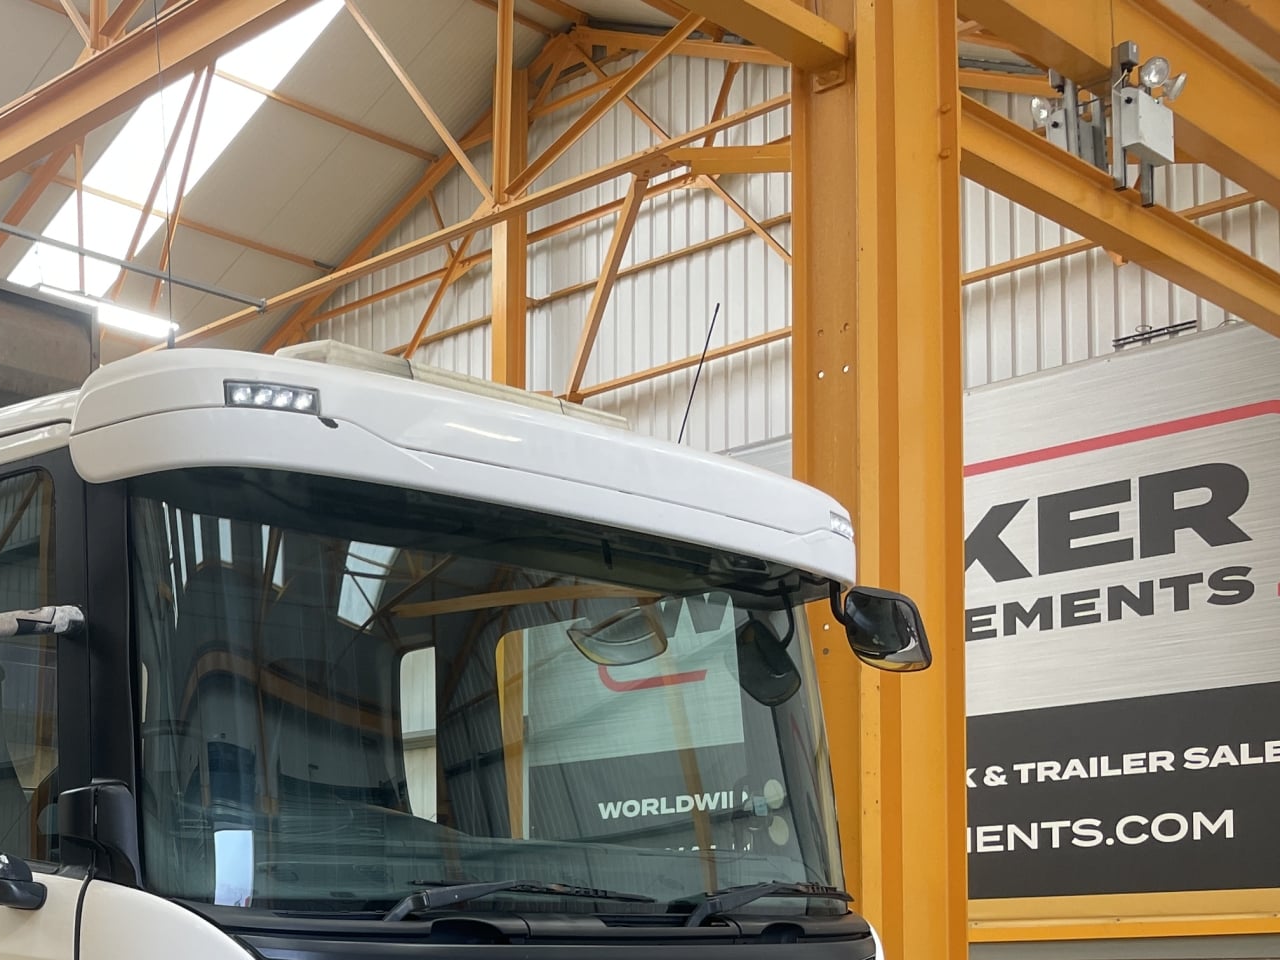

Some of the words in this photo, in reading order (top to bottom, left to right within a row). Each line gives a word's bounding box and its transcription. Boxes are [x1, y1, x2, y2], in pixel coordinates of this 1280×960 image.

[965, 462, 1253, 583] KER
[965, 566, 1255, 641] EMENTS
[983, 765, 1008, 787] &
[1013, 749, 1175, 784] TRAILER
[1183, 740, 1280, 770] SALE
[966, 809, 1234, 854] ENTS.COM
